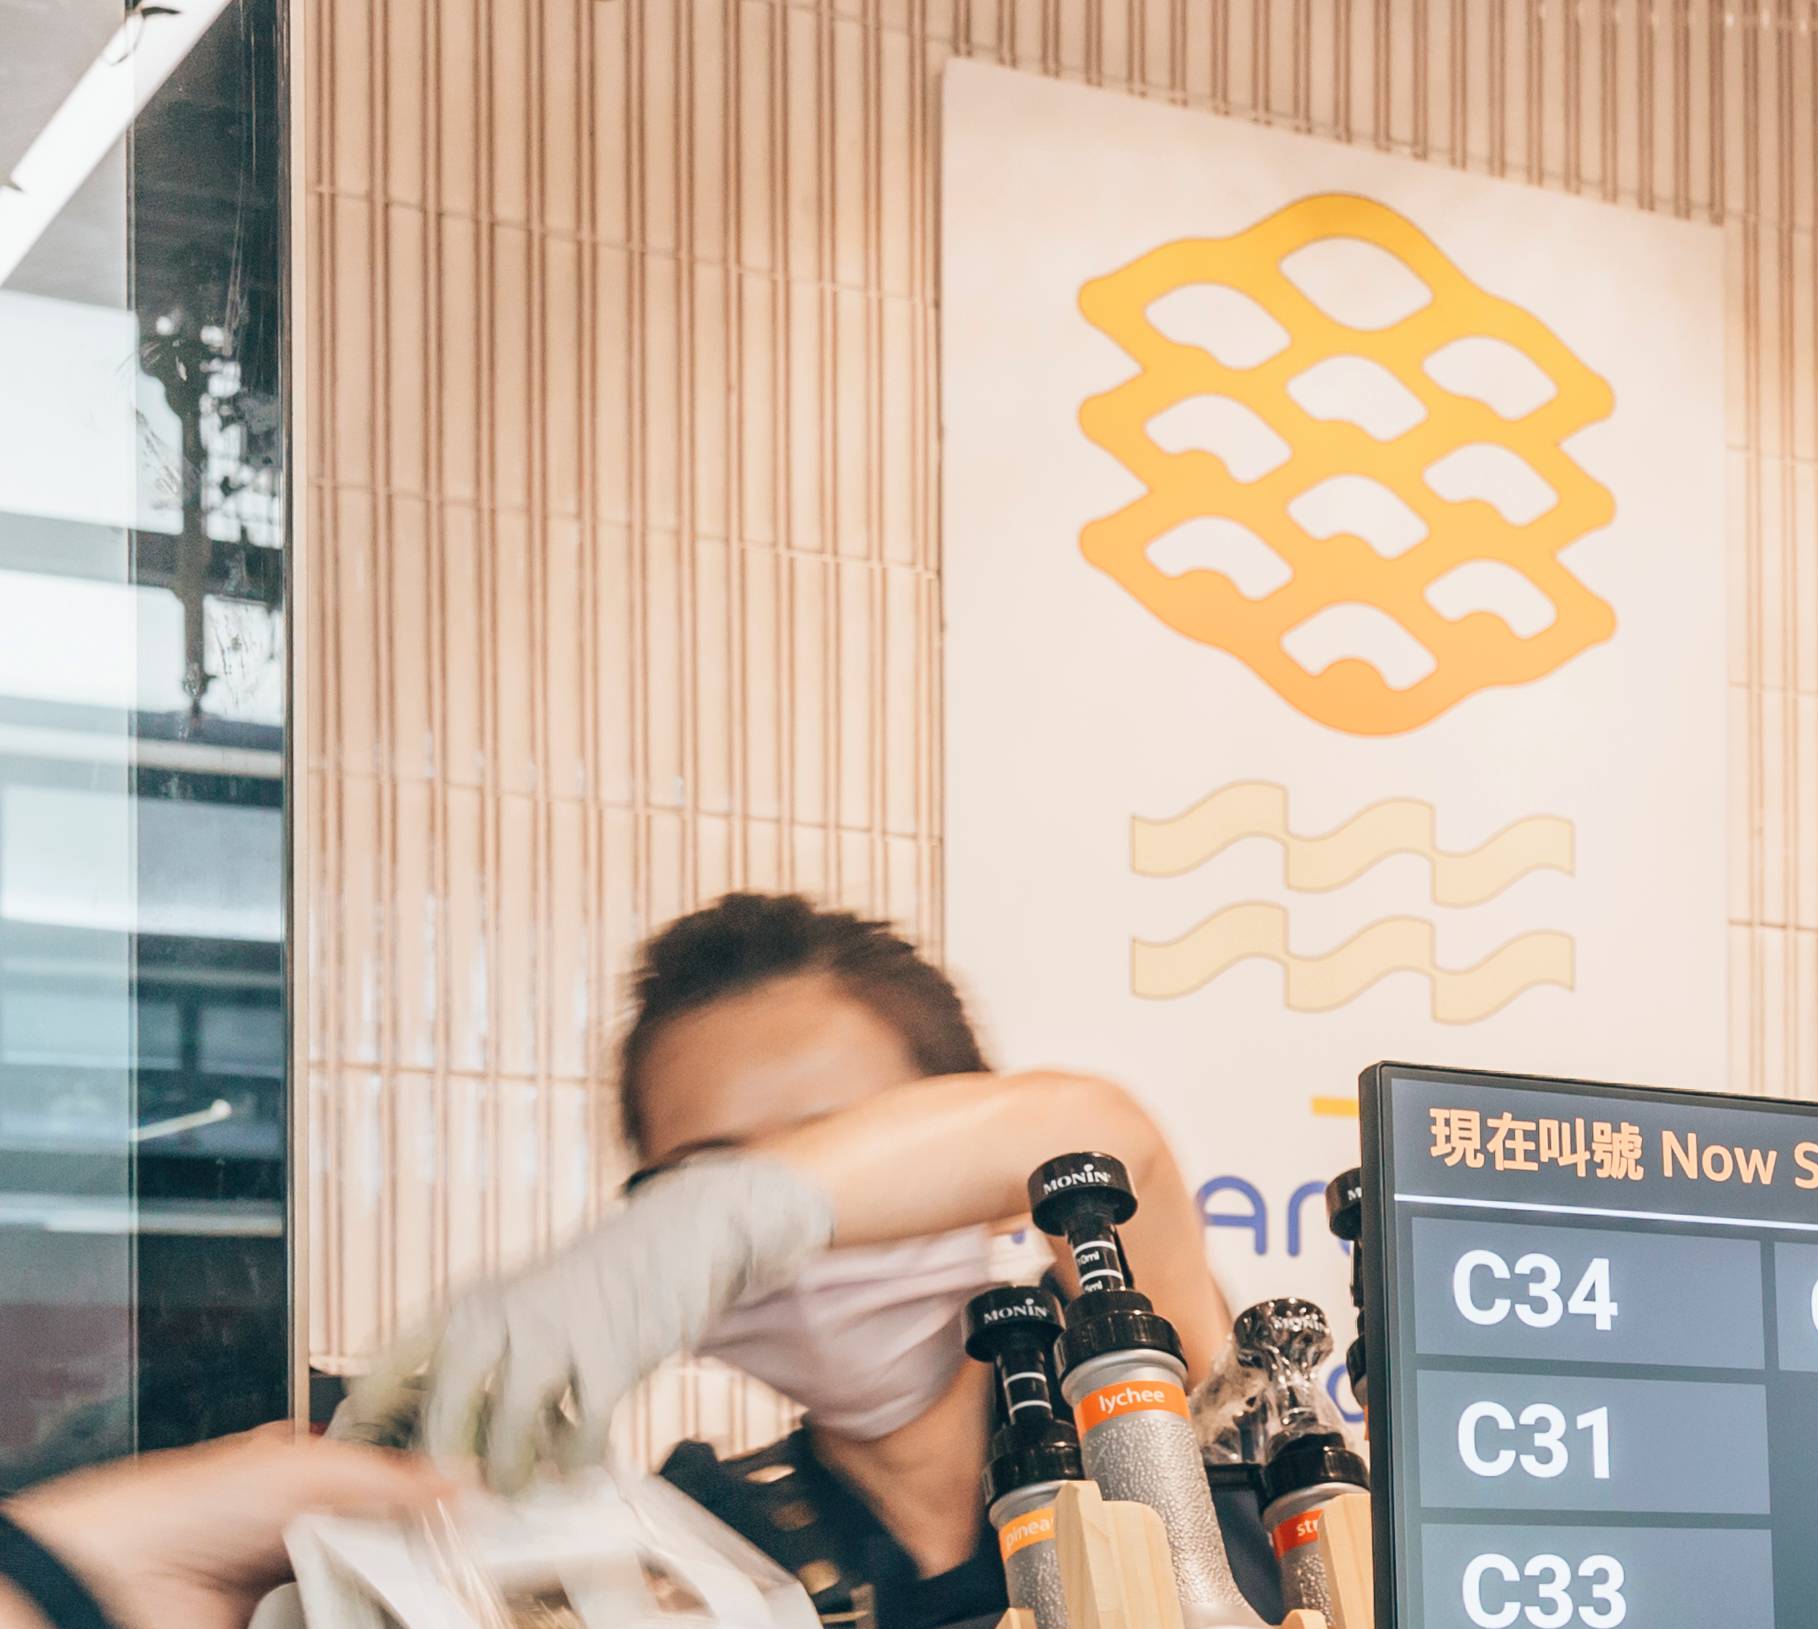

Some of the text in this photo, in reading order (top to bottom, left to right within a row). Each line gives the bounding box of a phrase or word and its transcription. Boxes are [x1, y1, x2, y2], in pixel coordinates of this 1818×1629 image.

[1429, 1106, 1645, 1181] 現在叫號
[1661, 1130, 1778, 1185] Now
[1042, 1163, 1111, 1195] MONIN
[983, 1297, 1048, 1324] MONIN
[1453, 1249, 1618, 1331] C34
[1099, 1387, 1166, 1413] lychee
[1457, 1401, 1610, 1479] C31
[1004, 1518, 1055, 1549] pinea
[1462, 1553, 1627, 1629] C33
